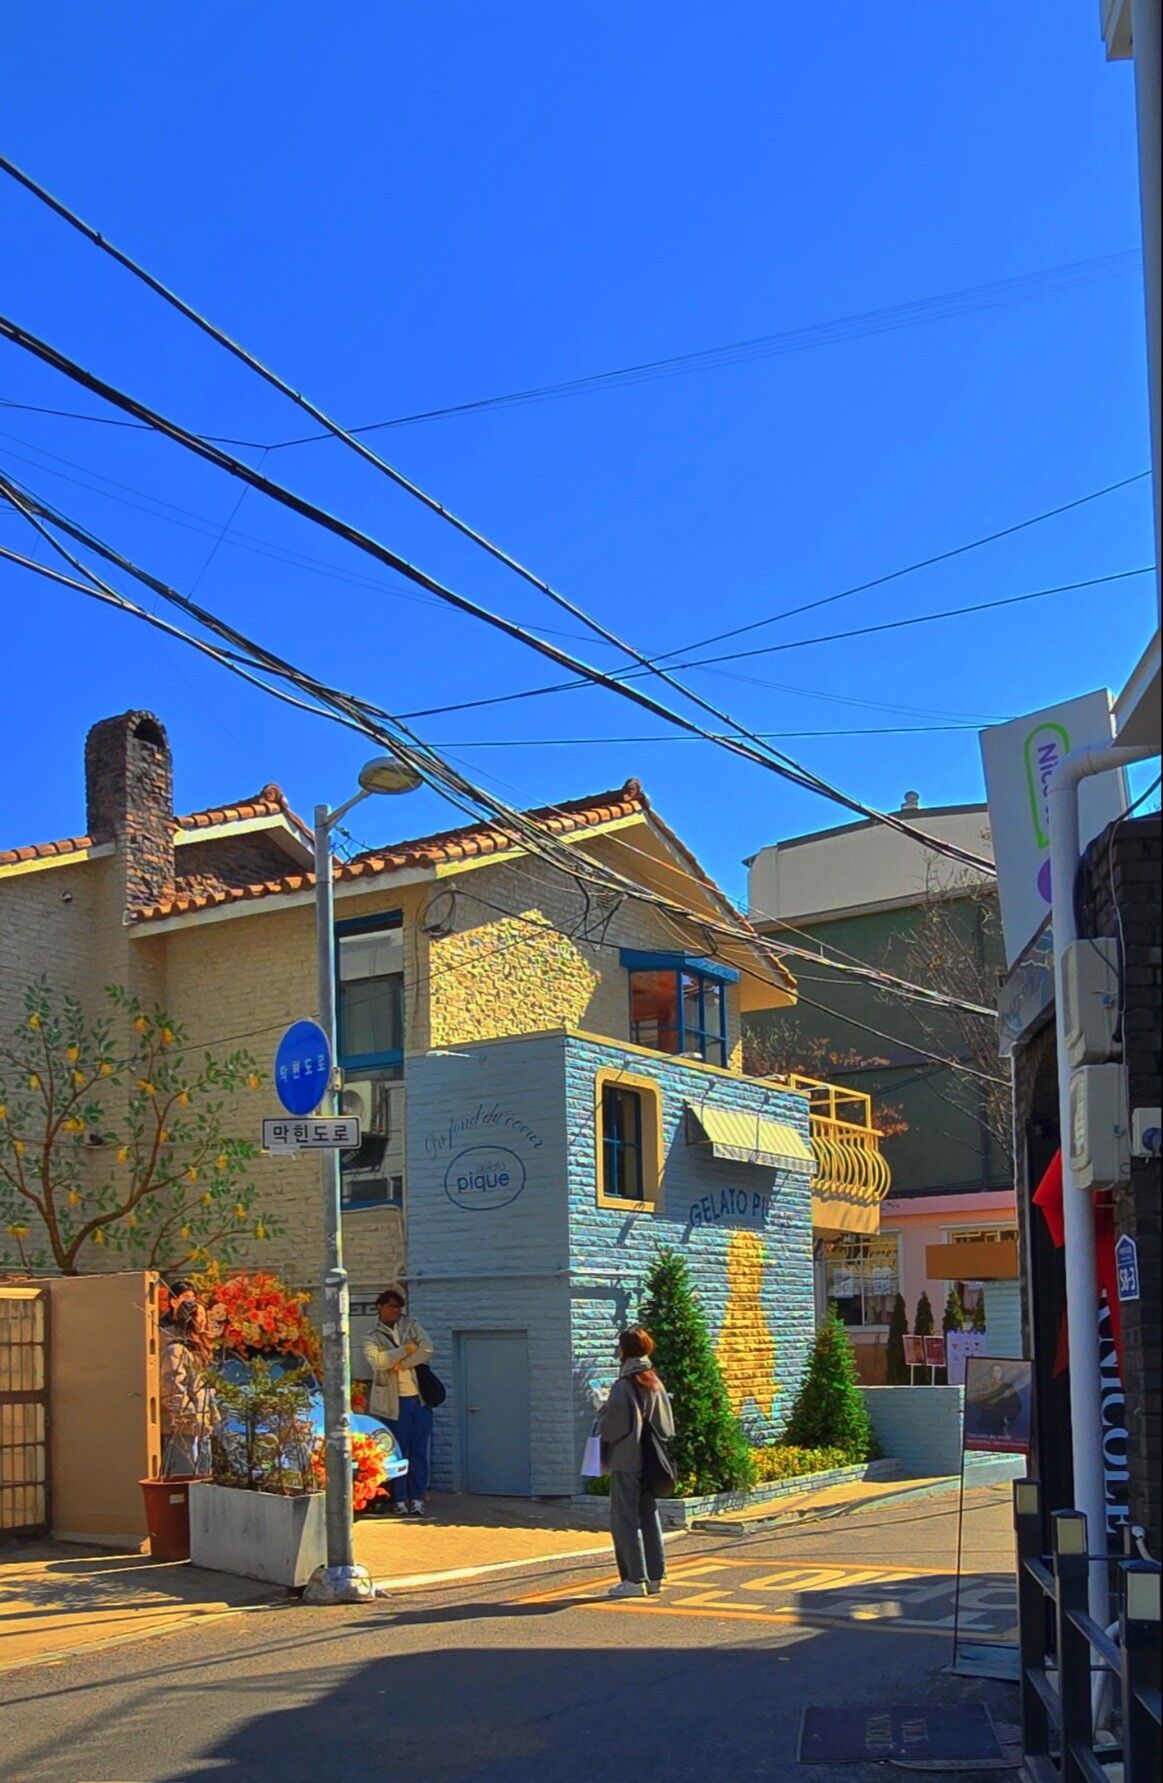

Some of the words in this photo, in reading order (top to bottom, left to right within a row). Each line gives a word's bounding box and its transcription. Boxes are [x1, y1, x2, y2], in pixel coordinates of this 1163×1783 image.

[273, 1124, 349, 1144] 막힌도로
[457, 1171, 510, 1195] pique
[689, 1187, 748, 1226] GELATO
